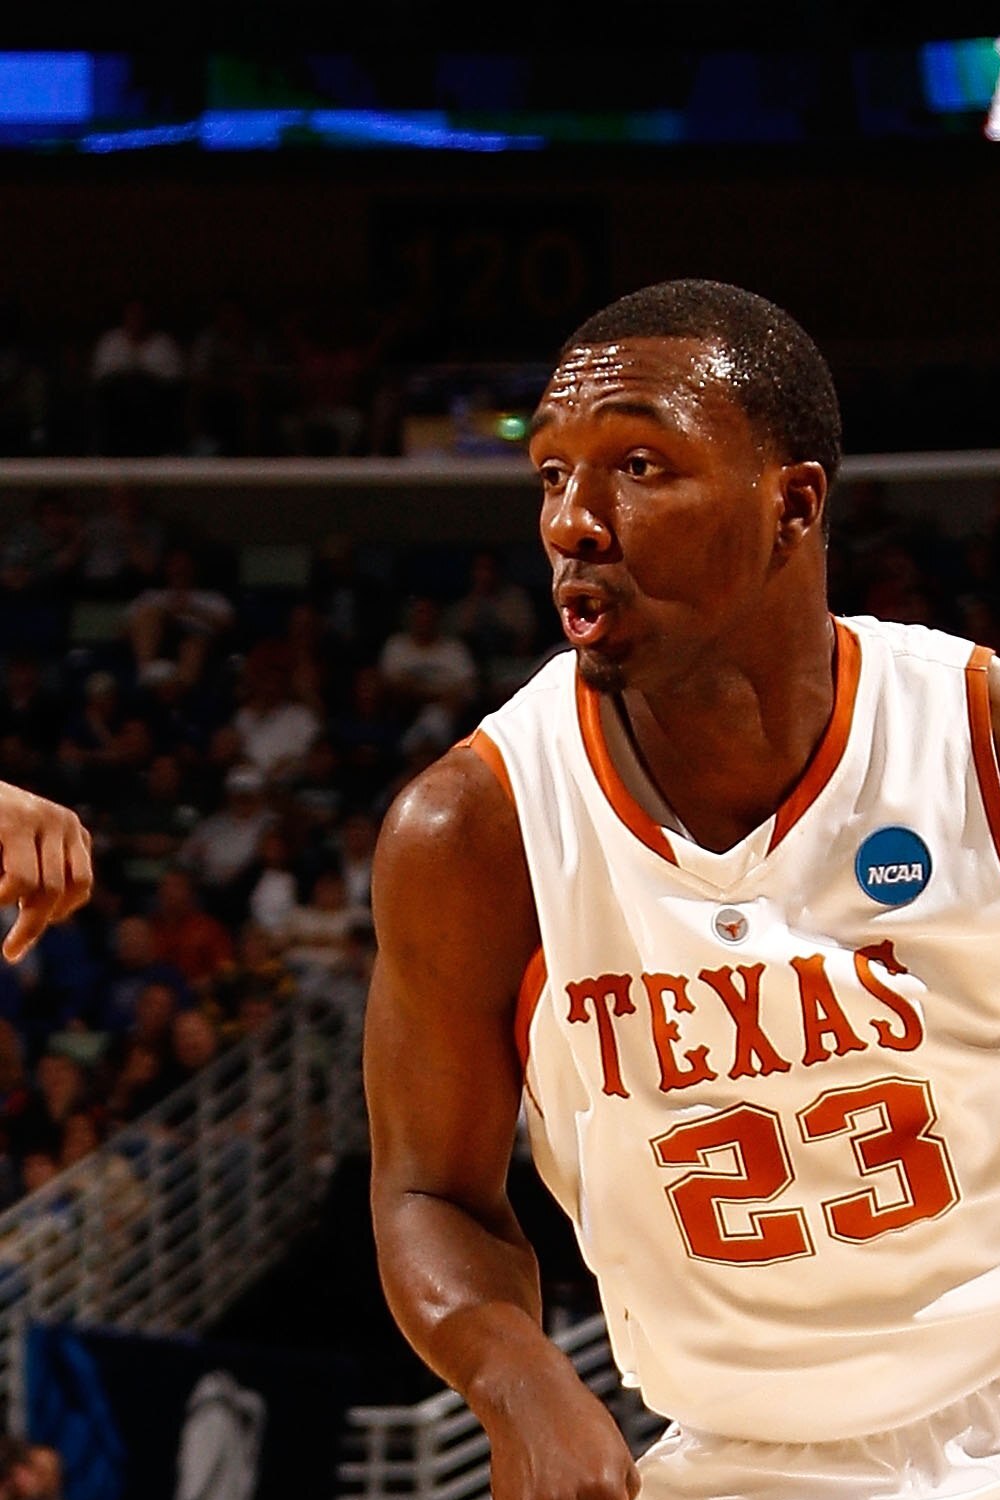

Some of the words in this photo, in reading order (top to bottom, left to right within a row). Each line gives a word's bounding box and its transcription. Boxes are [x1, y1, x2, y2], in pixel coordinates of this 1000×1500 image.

[866, 863, 925, 885] NCAA
[565, 938, 925, 1099] TEXAS
[648, 1076, 962, 1267] 23
